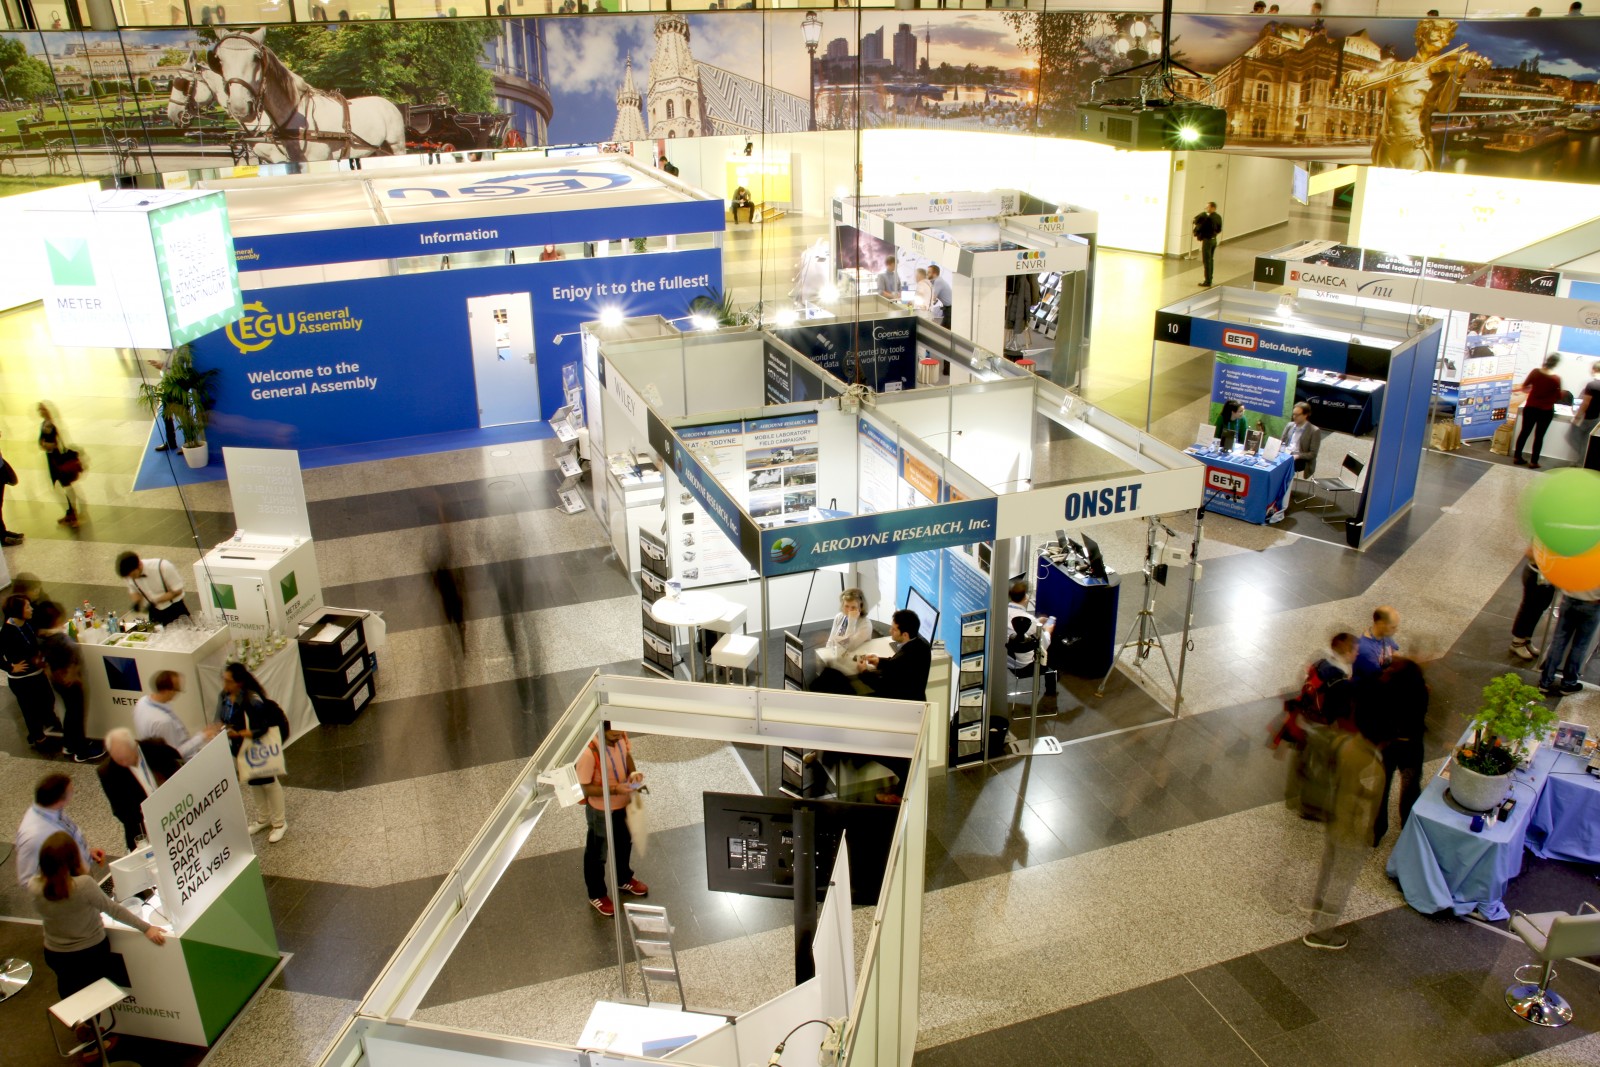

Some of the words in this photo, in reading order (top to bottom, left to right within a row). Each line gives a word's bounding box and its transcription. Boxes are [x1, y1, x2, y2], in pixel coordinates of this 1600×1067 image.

[928, 204, 953, 213] ENVRI
[420, 228, 499, 245] Information
[1016, 259, 1046, 270] ENVRI
[1265, 267, 1274, 276] 11
[1377, 262, 1390, 270] and
[1392, 264, 1420, 274] Isotopic
[553, 285, 593, 302] Enjoy
[597, 282, 608, 296] it
[611, 281, 627, 294] to
[630, 278, 656, 293] the
[659, 274, 709, 291] fullest!
[1301, 273, 1347, 288] CAMECA
[57, 298, 102, 310] METER
[239, 312, 297, 340] EGU
[297, 307, 350, 323] General
[298, 318, 363, 335] Assembly
[1167, 323, 1179, 334] 10
[872, 326, 910, 341] Copernicus
[880, 347, 889, 356] by
[889, 345, 905, 354] tools
[1227, 334, 1253, 347] BETA
[1259, 340, 1279, 352] Beta
[1279, 343, 1313, 357] Analytic
[829, 351, 837, 360] of
[877, 355, 887, 363] for
[888, 355, 900, 364] you
[248, 369, 314, 384] Welcome
[317, 365, 333, 377] to
[335, 361, 360, 375] the
[823, 361, 839, 369] data
[251, 383, 307, 401] General
[310, 375, 378, 394] Assembly
[614, 377, 636, 417] WILEY
[754, 433, 775, 441] MOBILE
[776, 429, 811, 439] LABORATORY
[776, 436, 807, 445] CAMPAIGNS
[1213, 474, 1242, 489] BETA
[684, 467, 707, 500] AERODYNE
[706, 491, 730, 528] RESEARCH,
[729, 520, 739, 537] Inc.
[1064, 483, 1142, 522] ONSET
[811, 531, 889, 555] AERODYNE
[892, 520, 964, 544] RESEARCH,
[968, 518, 991, 531] Inc.
[285, 600, 301, 616] METER
[286, 594, 317, 623] ENVIRONMENT
[160, 793, 194, 832] PARIO
[165, 778, 229, 848] AUTOMATED
[168, 832, 196, 861] SOIL
[173, 819, 223, 876] PARTICLE
[176, 859, 202, 890] SIZE
[181, 846, 231, 906] ANALYSIS
